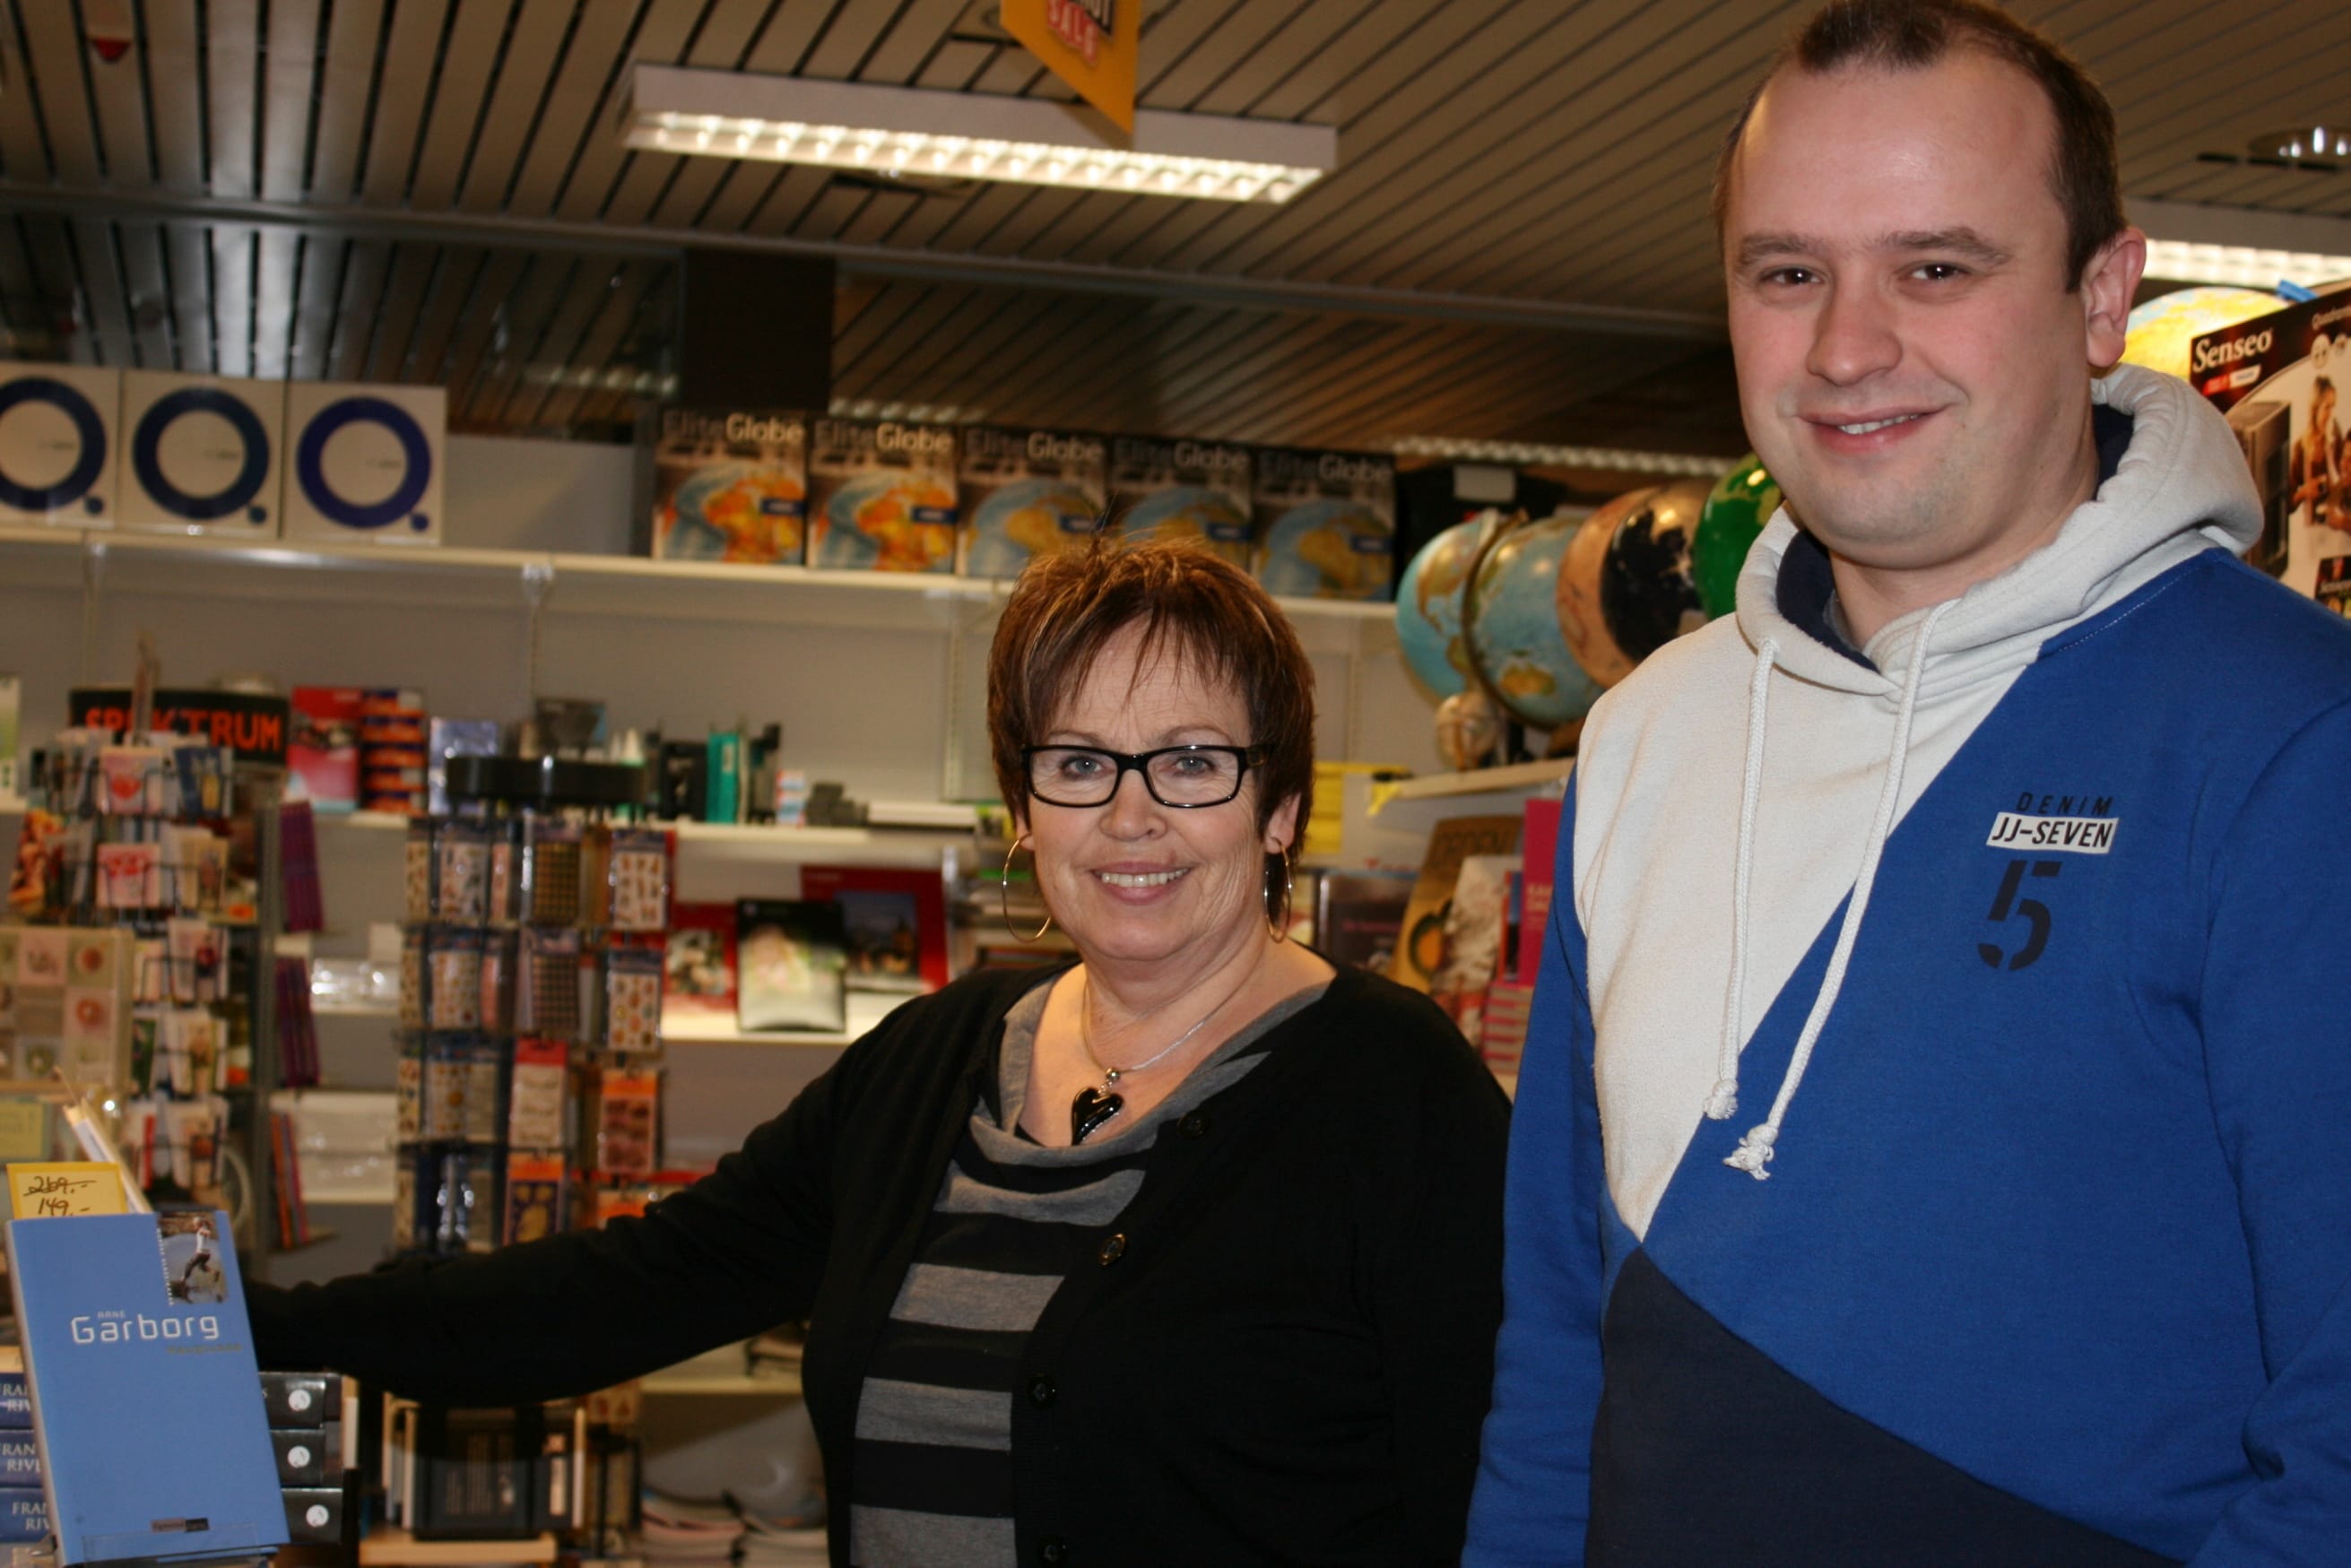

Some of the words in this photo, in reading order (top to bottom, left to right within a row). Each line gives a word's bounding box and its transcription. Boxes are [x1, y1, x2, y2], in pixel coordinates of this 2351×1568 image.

[2192, 328, 2273, 373] Senseo
[85, 706, 281, 751] SPKTRUM
[2016, 792, 2114, 816] DENIM
[1991, 817, 2113, 848] JJ-SEVEN
[1977, 860, 2062, 971] 5
[70, 1313, 221, 1345] Garborg
